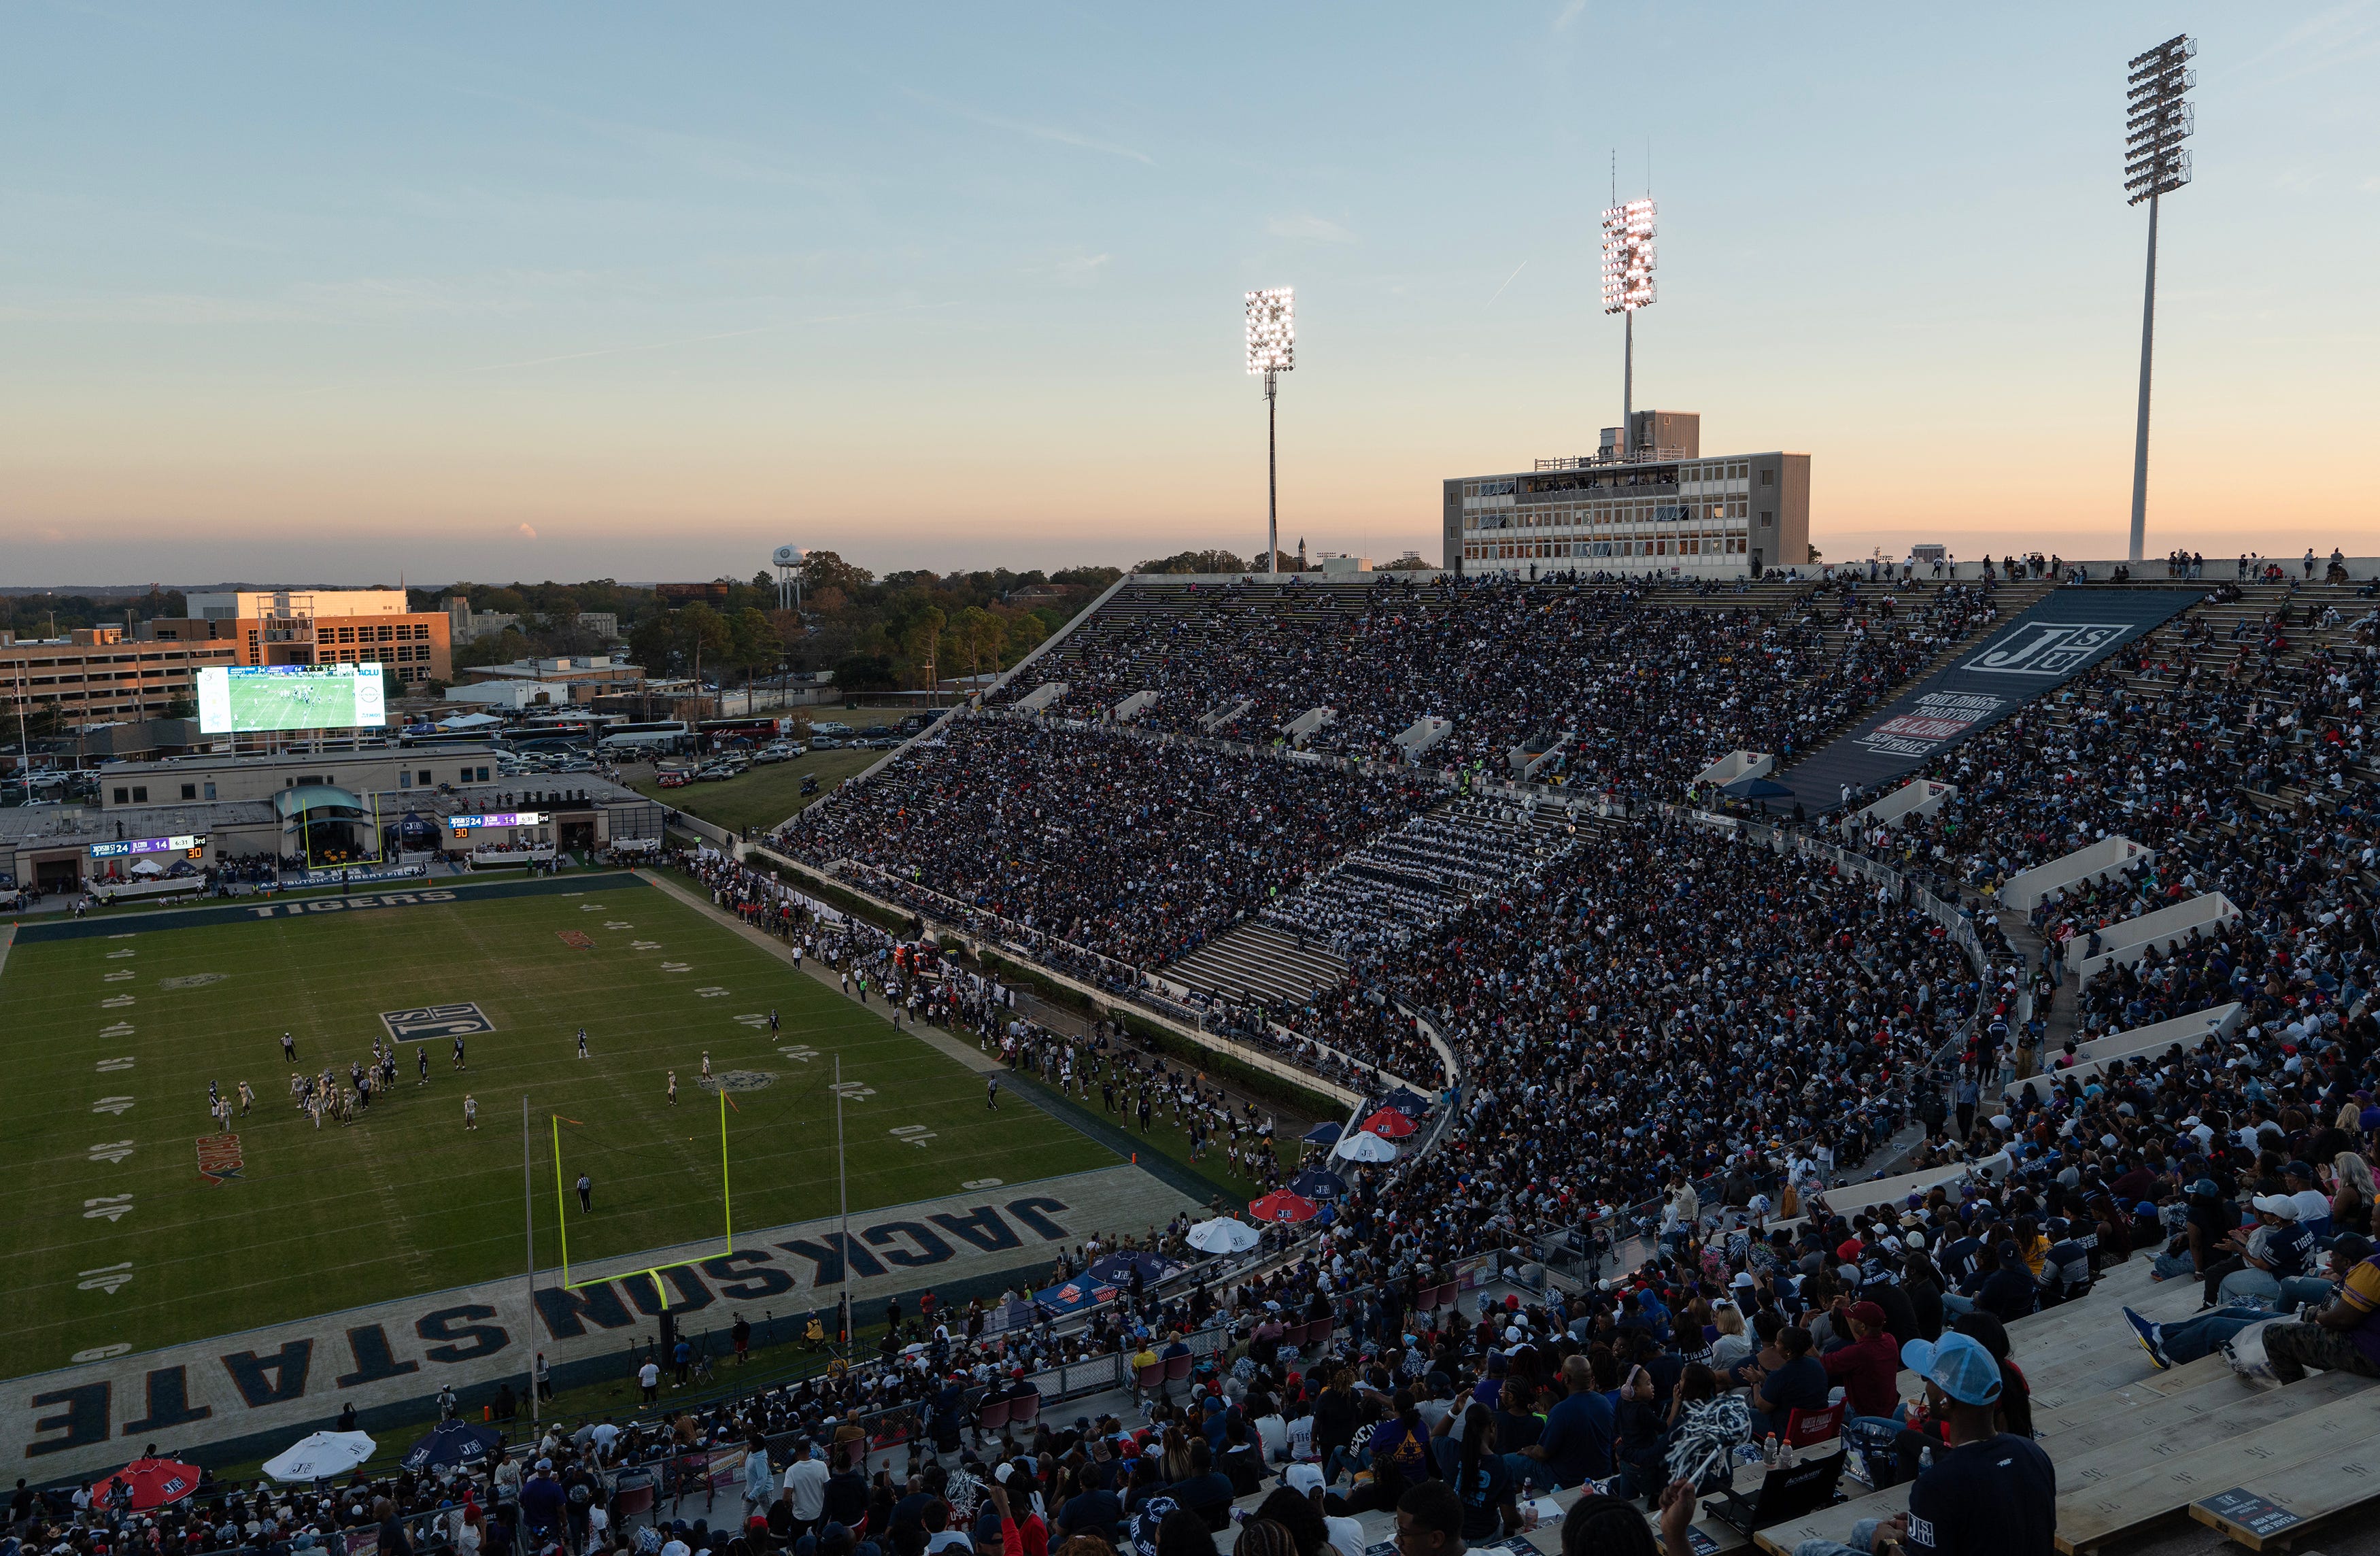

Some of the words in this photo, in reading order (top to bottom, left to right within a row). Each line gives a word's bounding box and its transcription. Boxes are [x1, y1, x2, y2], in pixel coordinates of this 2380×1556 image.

[1914, 692, 1996, 709] BUILDING
[1910, 706, 1992, 722] TRADITION
[1879, 717, 1967, 737] BLAZING
[1862, 732, 1899, 743] NEW
[1879, 739, 1938, 754] TRAILS
[470, 817, 481, 826] 24
[455, 828, 467, 838] 30
[116, 844, 129, 853] 24
[188, 847, 202, 858] 30
[282, 877, 328, 885] "BUTCH"
[248, 890, 458, 917] TIGERS
[384, 1004, 488, 1038] JSU
[99, 1025, 135, 1038] 40
[777, 1045, 820, 1058] 30
[96, 1055, 135, 1072] 50
[828, 1081, 877, 1098] 20
[92, 1096, 135, 1113] 40
[889, 1124, 938, 1143] 10
[88, 1140, 135, 1161] 30
[195, 1134, 245, 1172] SWAC
[1315, 1185, 1330, 1195] JSU
[84, 1194, 135, 1219] 20
[1277, 1209, 1293, 1218] JSU
[1234, 1236, 1247, 1246] JSU
[1571, 1236, 1580, 1245] 112
[1534, 1247, 1542, 1255] 113
[77, 1262, 134, 1289] 10
[533, 1196, 1070, 1340] JACKSON
[1873, 1272, 1888, 1282] STATE
[1057, 1289, 1082, 1303] GUARD
[71, 1342, 133, 1363] G
[1682, 1347, 1711, 1362] TIGERS
[25, 1304, 511, 1458] STATE
[459, 1439, 483, 1456] JSU
[290, 1462, 315, 1474] JSU
[1786, 1468, 1823, 1486] Academy
[161, 1476, 186, 1495] JSU
[2237, 1505, 2258, 1515] Practice
[2265, 1512, 2283, 1521] THIS
[2249, 1517, 2266, 1527] ROW
[2256, 1523, 2274, 1534] SKIP
[2273, 1515, 2298, 1527] PLEASE
[1908, 1513, 1933, 1546] JSU
